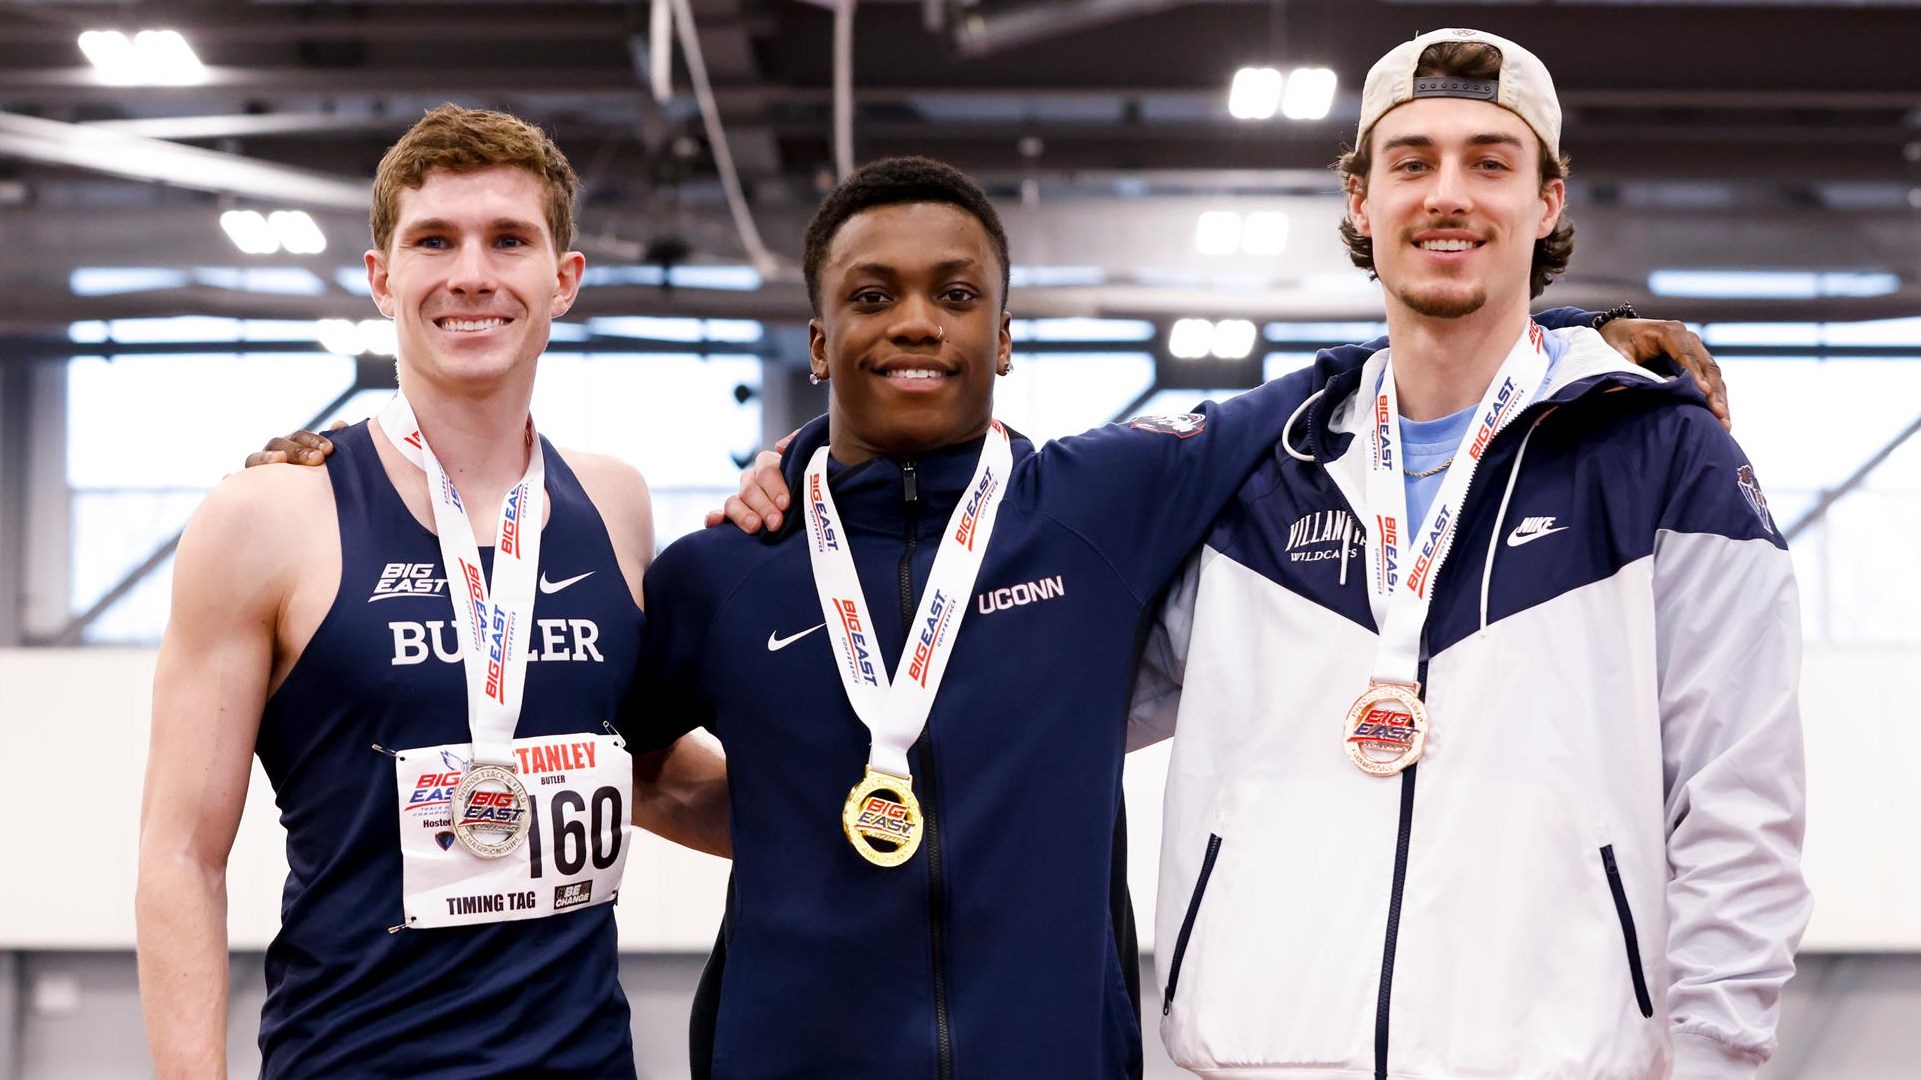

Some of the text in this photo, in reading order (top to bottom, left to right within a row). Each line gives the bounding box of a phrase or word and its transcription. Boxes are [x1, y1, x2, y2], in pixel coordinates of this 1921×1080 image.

[1285, 510, 1366, 552] VILLAN
[1517, 516, 1557, 533] NIKE
[1291, 548, 1357, 562] WILDCAS
[381, 563, 434, 578] BIG
[373, 579, 448, 593] EAST
[978, 575, 1065, 615] UCONN
[388, 618, 604, 666] BUER
[1364, 709, 1412, 727] BIG
[1354, 722, 1421, 741] EAST
[416, 772, 461, 788] BIG
[541, 775, 566, 785] BUTLER
[409, 787, 455, 803] EAS
[472, 791, 514, 807] BIG
[464, 806, 525, 822] EAST
[866, 799, 908, 818] BIG
[858, 811, 915, 833] EAST
[528, 785, 623, 879] 160
[564, 884, 581, 898] BE
[446, 891, 536, 915] TIMING TAG
[556, 892, 590, 907] CHANGE
